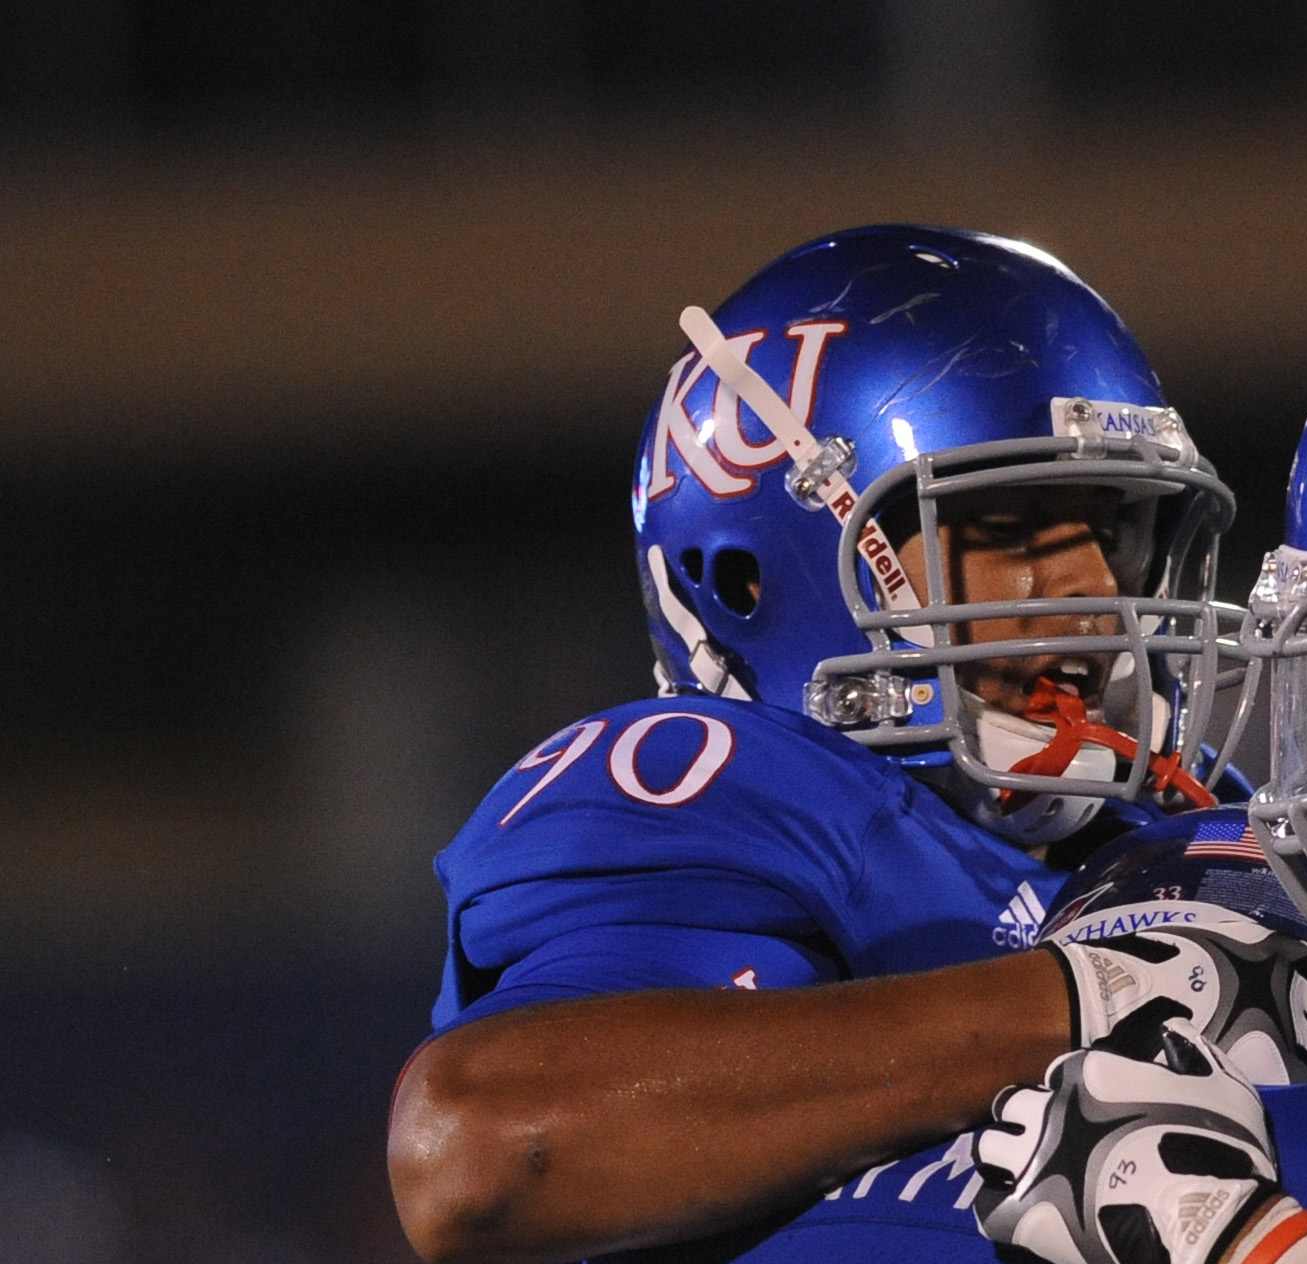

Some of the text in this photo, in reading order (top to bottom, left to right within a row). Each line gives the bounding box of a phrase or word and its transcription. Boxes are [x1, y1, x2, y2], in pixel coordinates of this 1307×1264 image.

[645, 318, 850, 500] KU
[497, 711, 738, 829] 90
[1108, 1159, 1138, 1190] 93
[1185, 1189, 1231, 1246] adidas
